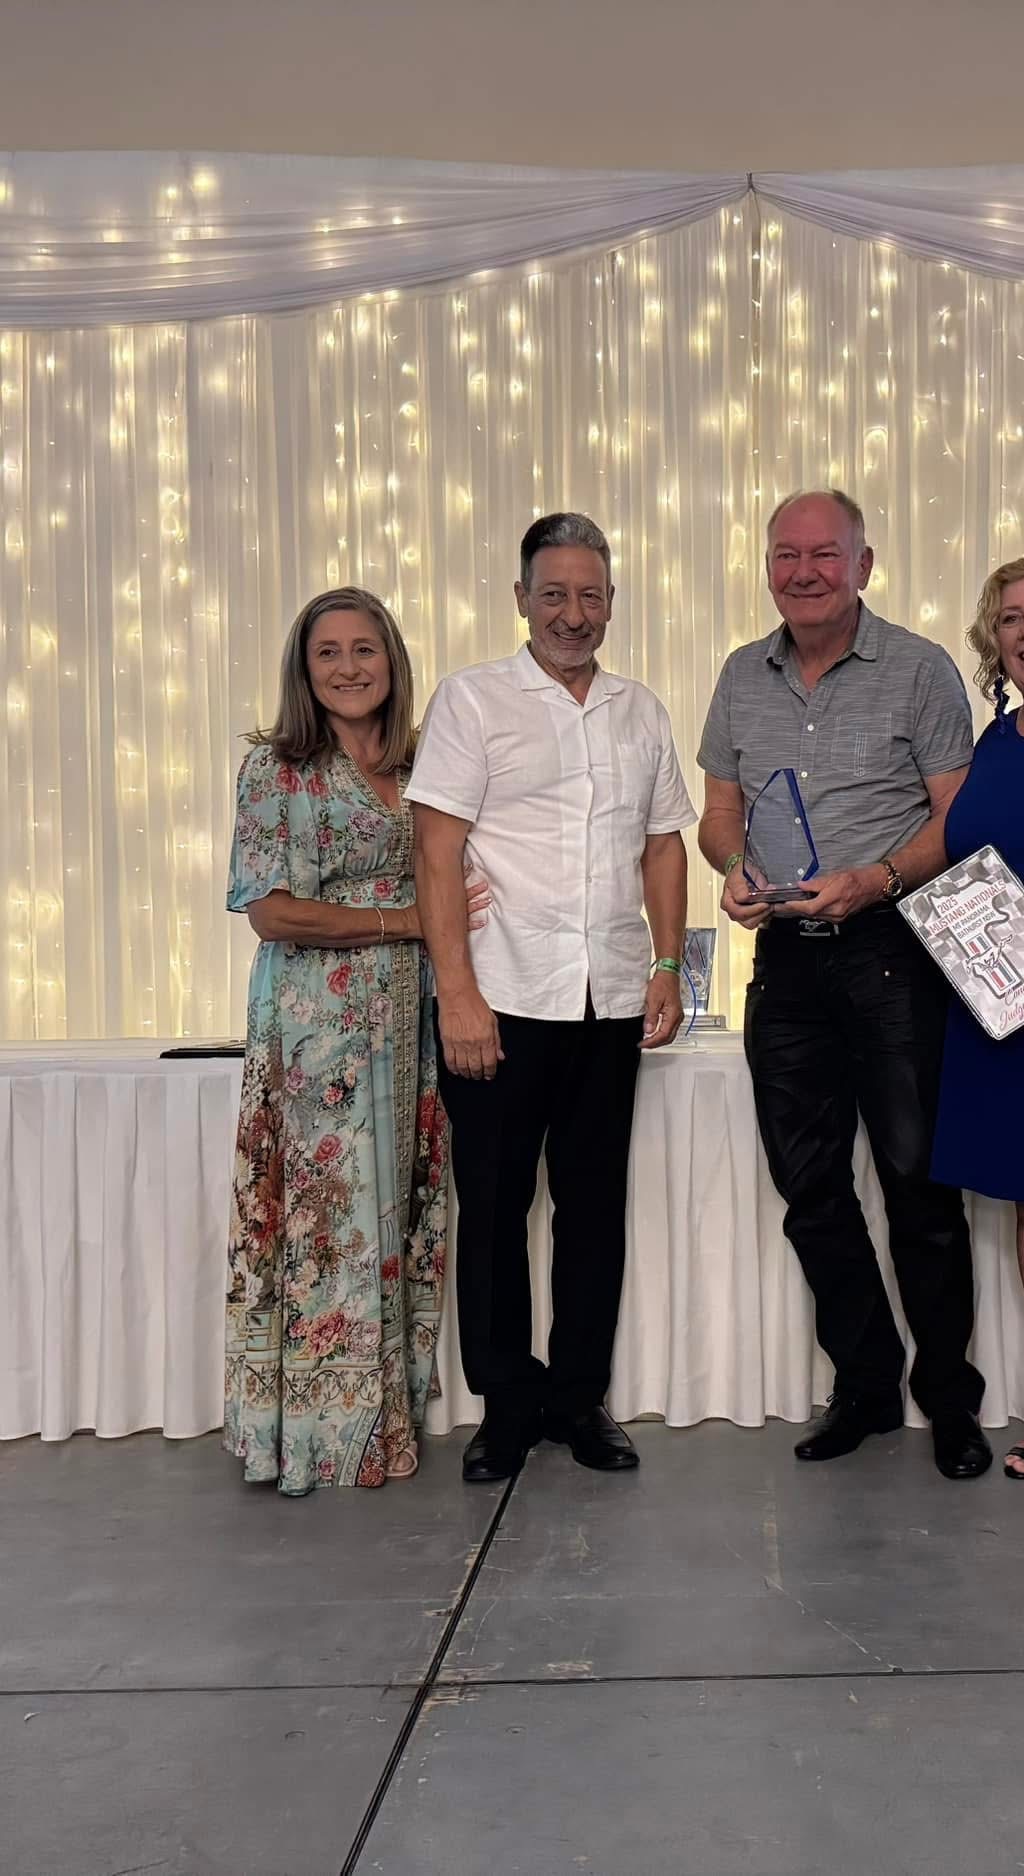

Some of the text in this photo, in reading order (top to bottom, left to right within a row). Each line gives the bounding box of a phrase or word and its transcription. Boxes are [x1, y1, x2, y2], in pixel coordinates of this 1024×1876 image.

[929, 880, 1007, 934] MUSTANG NATIONALS
[937, 896, 958, 914] 2025
[961, 904, 990, 925] PANORAMA
[957, 918, 983, 939] BATHURST
